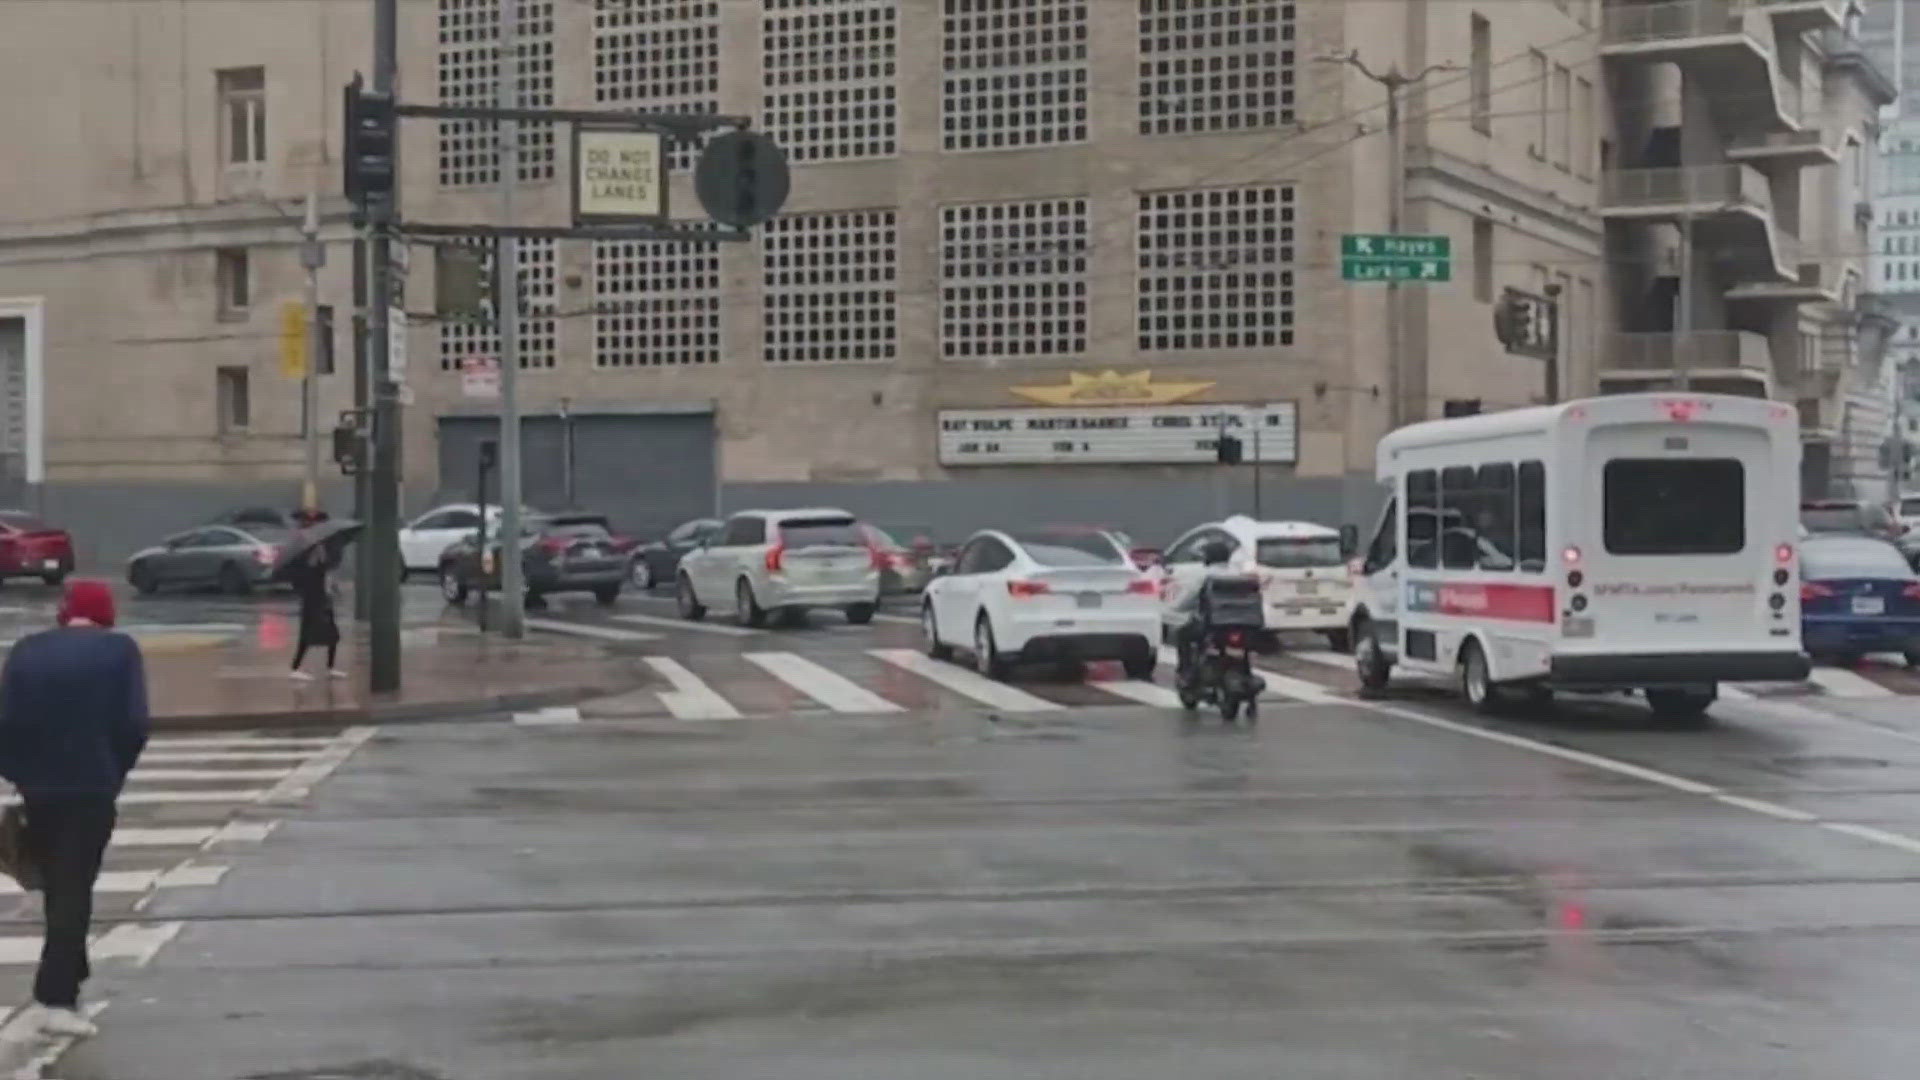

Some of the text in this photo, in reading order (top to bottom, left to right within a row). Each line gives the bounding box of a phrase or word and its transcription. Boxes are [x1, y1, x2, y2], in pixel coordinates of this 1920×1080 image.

[587, 149, 650, 164] DO NOT
[586, 167, 652, 183] CHANGE
[591, 184, 647, 199] LANES
